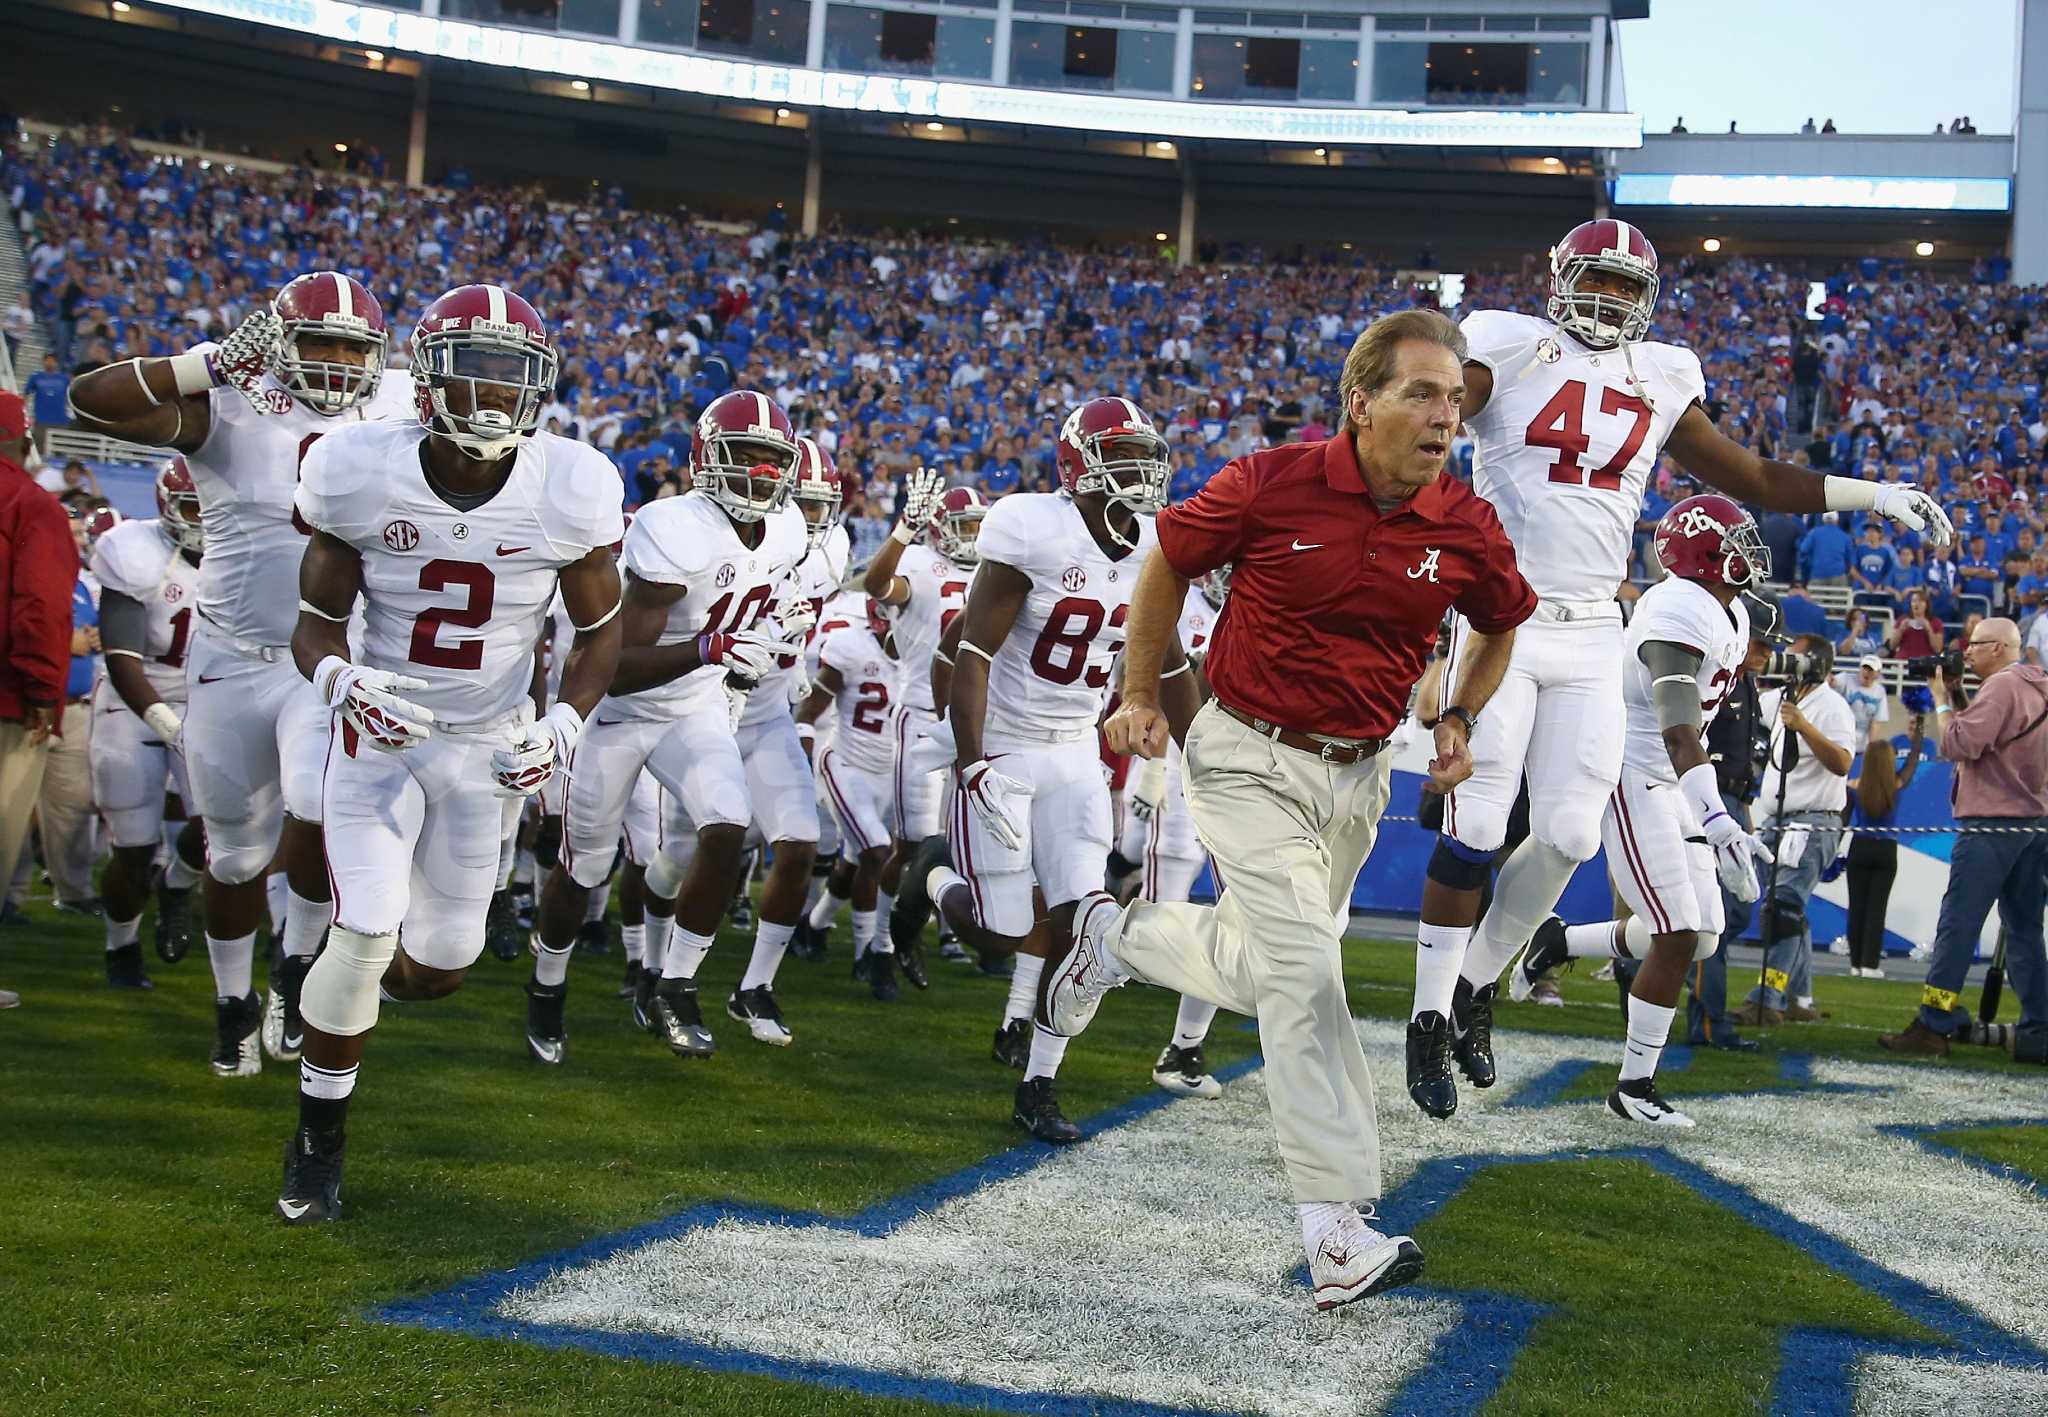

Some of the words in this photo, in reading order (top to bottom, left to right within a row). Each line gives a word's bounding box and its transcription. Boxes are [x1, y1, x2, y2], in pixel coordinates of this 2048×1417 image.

[485, 322, 513, 334] BAMA
[1525, 379, 1655, 491] 47
[384, 520, 419, 551] SEC
[1678, 506, 1711, 539] 26
[716, 564, 735, 588] SEC
[1062, 567, 1086, 592] SEC
[408, 559, 496, 670] 2
[852, 682, 889, 734] 2
